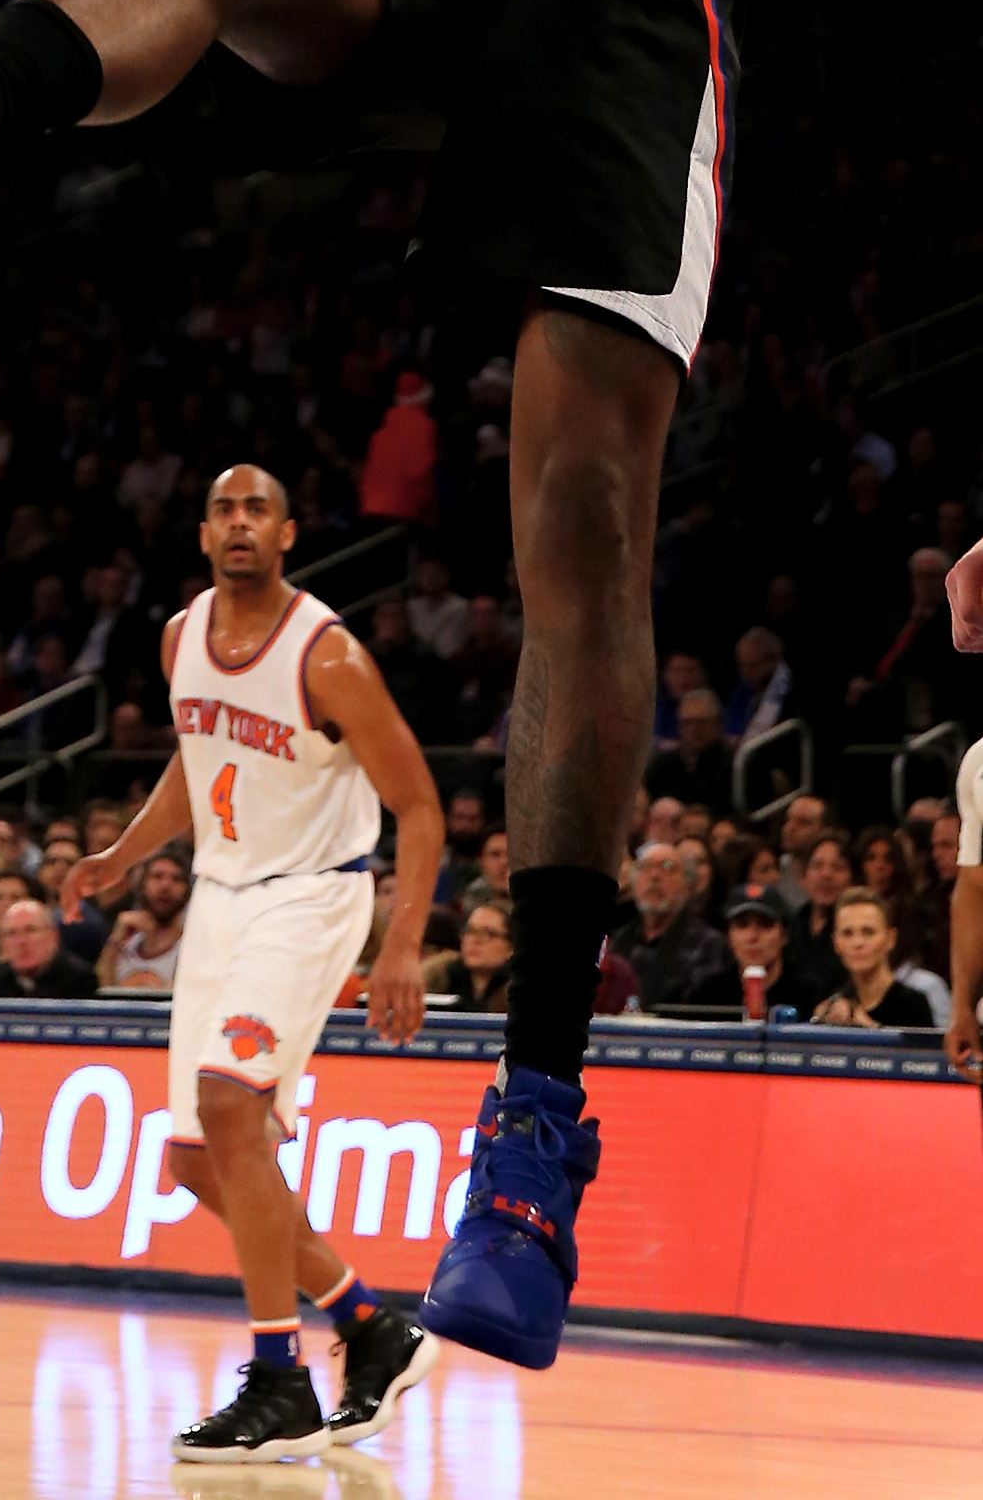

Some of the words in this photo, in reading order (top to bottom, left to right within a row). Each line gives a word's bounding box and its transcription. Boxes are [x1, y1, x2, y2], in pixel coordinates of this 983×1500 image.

[175, 698, 222, 736] EW
[224, 703, 296, 762] YORK
[210, 763, 238, 842] 4
[38, 1064, 478, 1259] Opim
